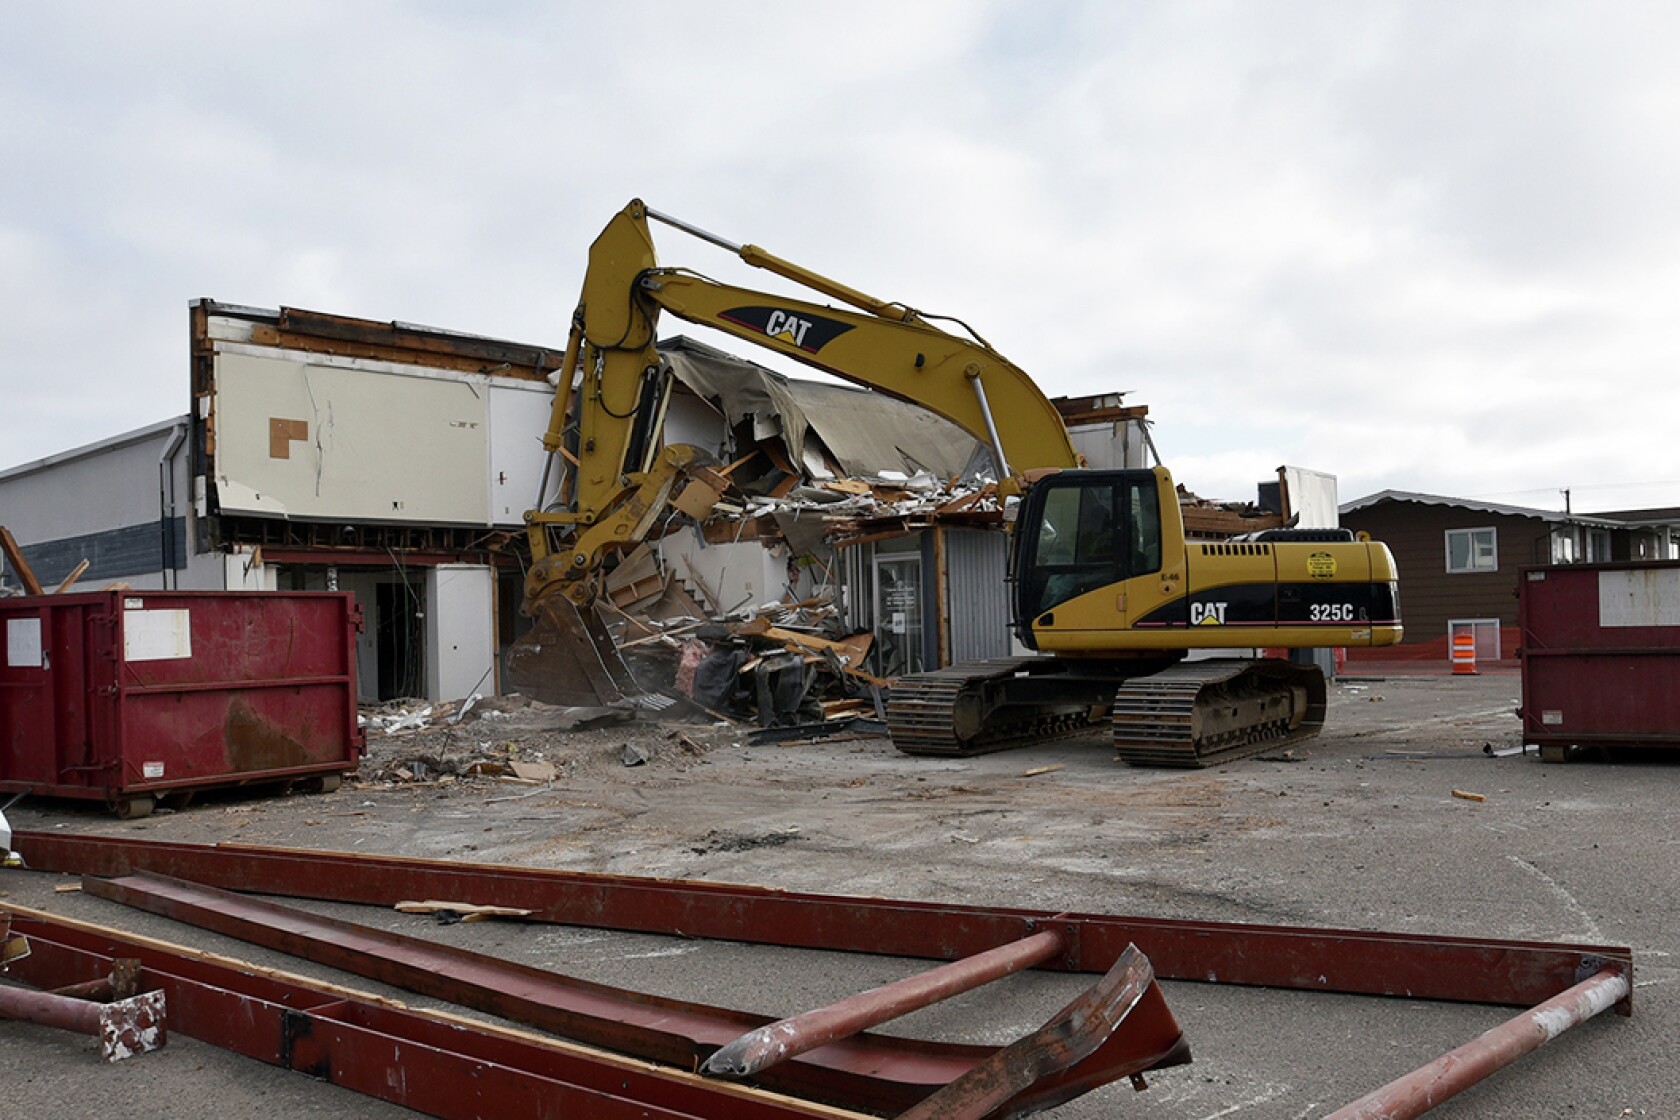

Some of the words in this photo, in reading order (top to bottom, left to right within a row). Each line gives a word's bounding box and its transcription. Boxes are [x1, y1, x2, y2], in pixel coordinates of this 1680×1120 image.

[766, 310, 813, 347] CAT
[1190, 602, 1228, 625] CAT
[1310, 603, 1354, 621] 325C
